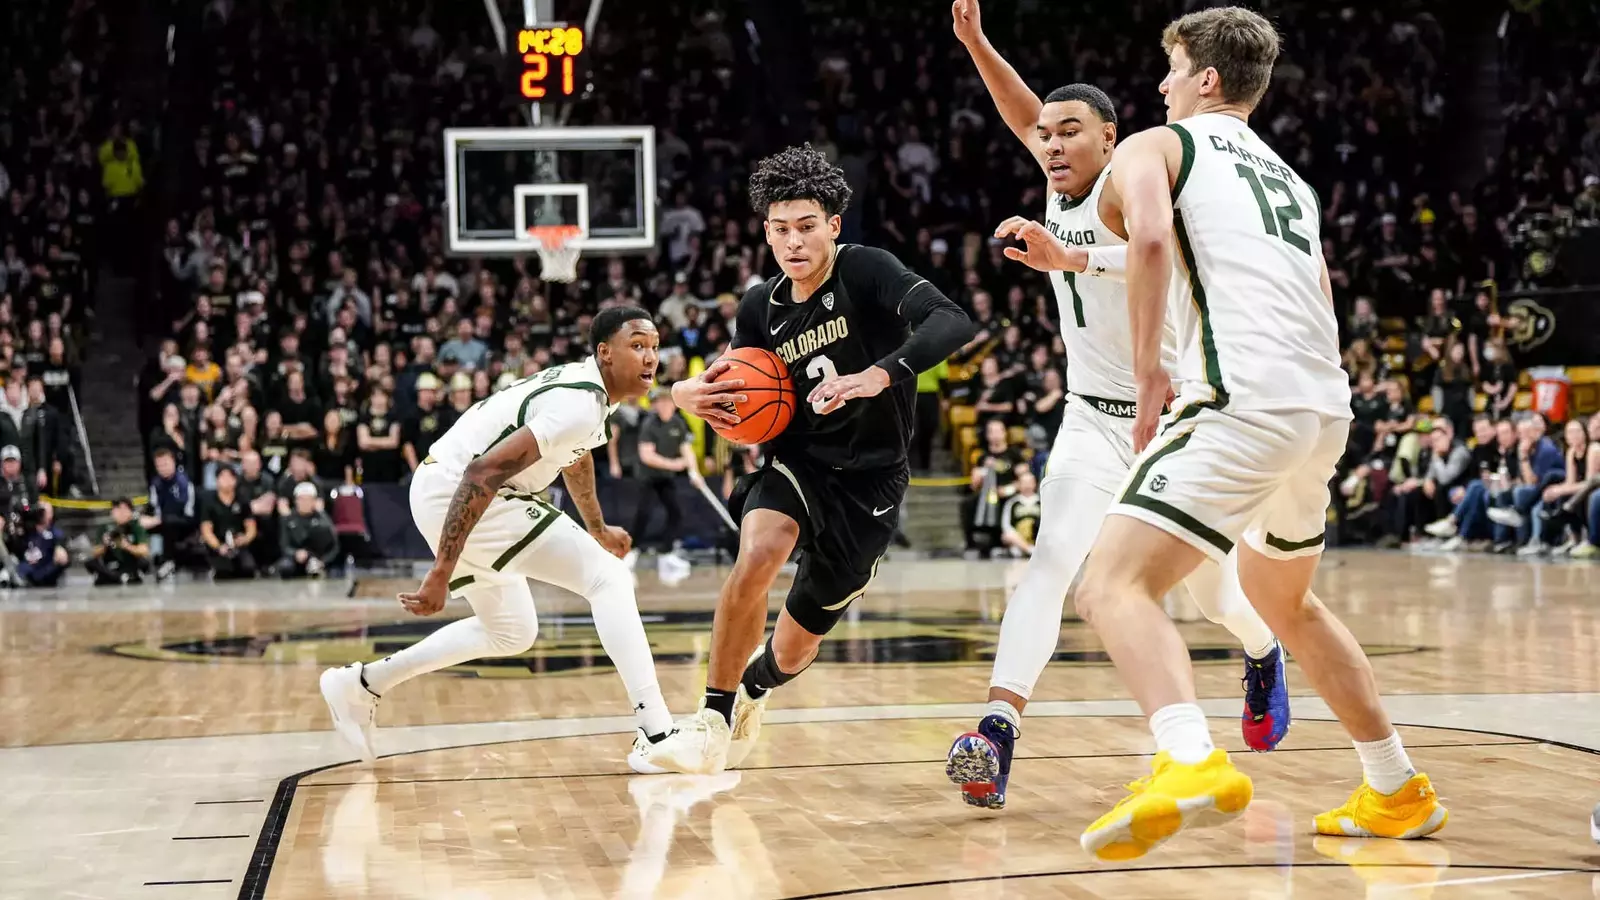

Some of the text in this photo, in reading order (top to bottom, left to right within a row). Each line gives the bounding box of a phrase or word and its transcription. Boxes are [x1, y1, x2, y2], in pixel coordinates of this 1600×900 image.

[520, 53, 574, 98] 21
[1208, 135, 1296, 185] CARTIER
[1234, 163, 1312, 256] 12
[776, 316, 848, 366] COLORADO
